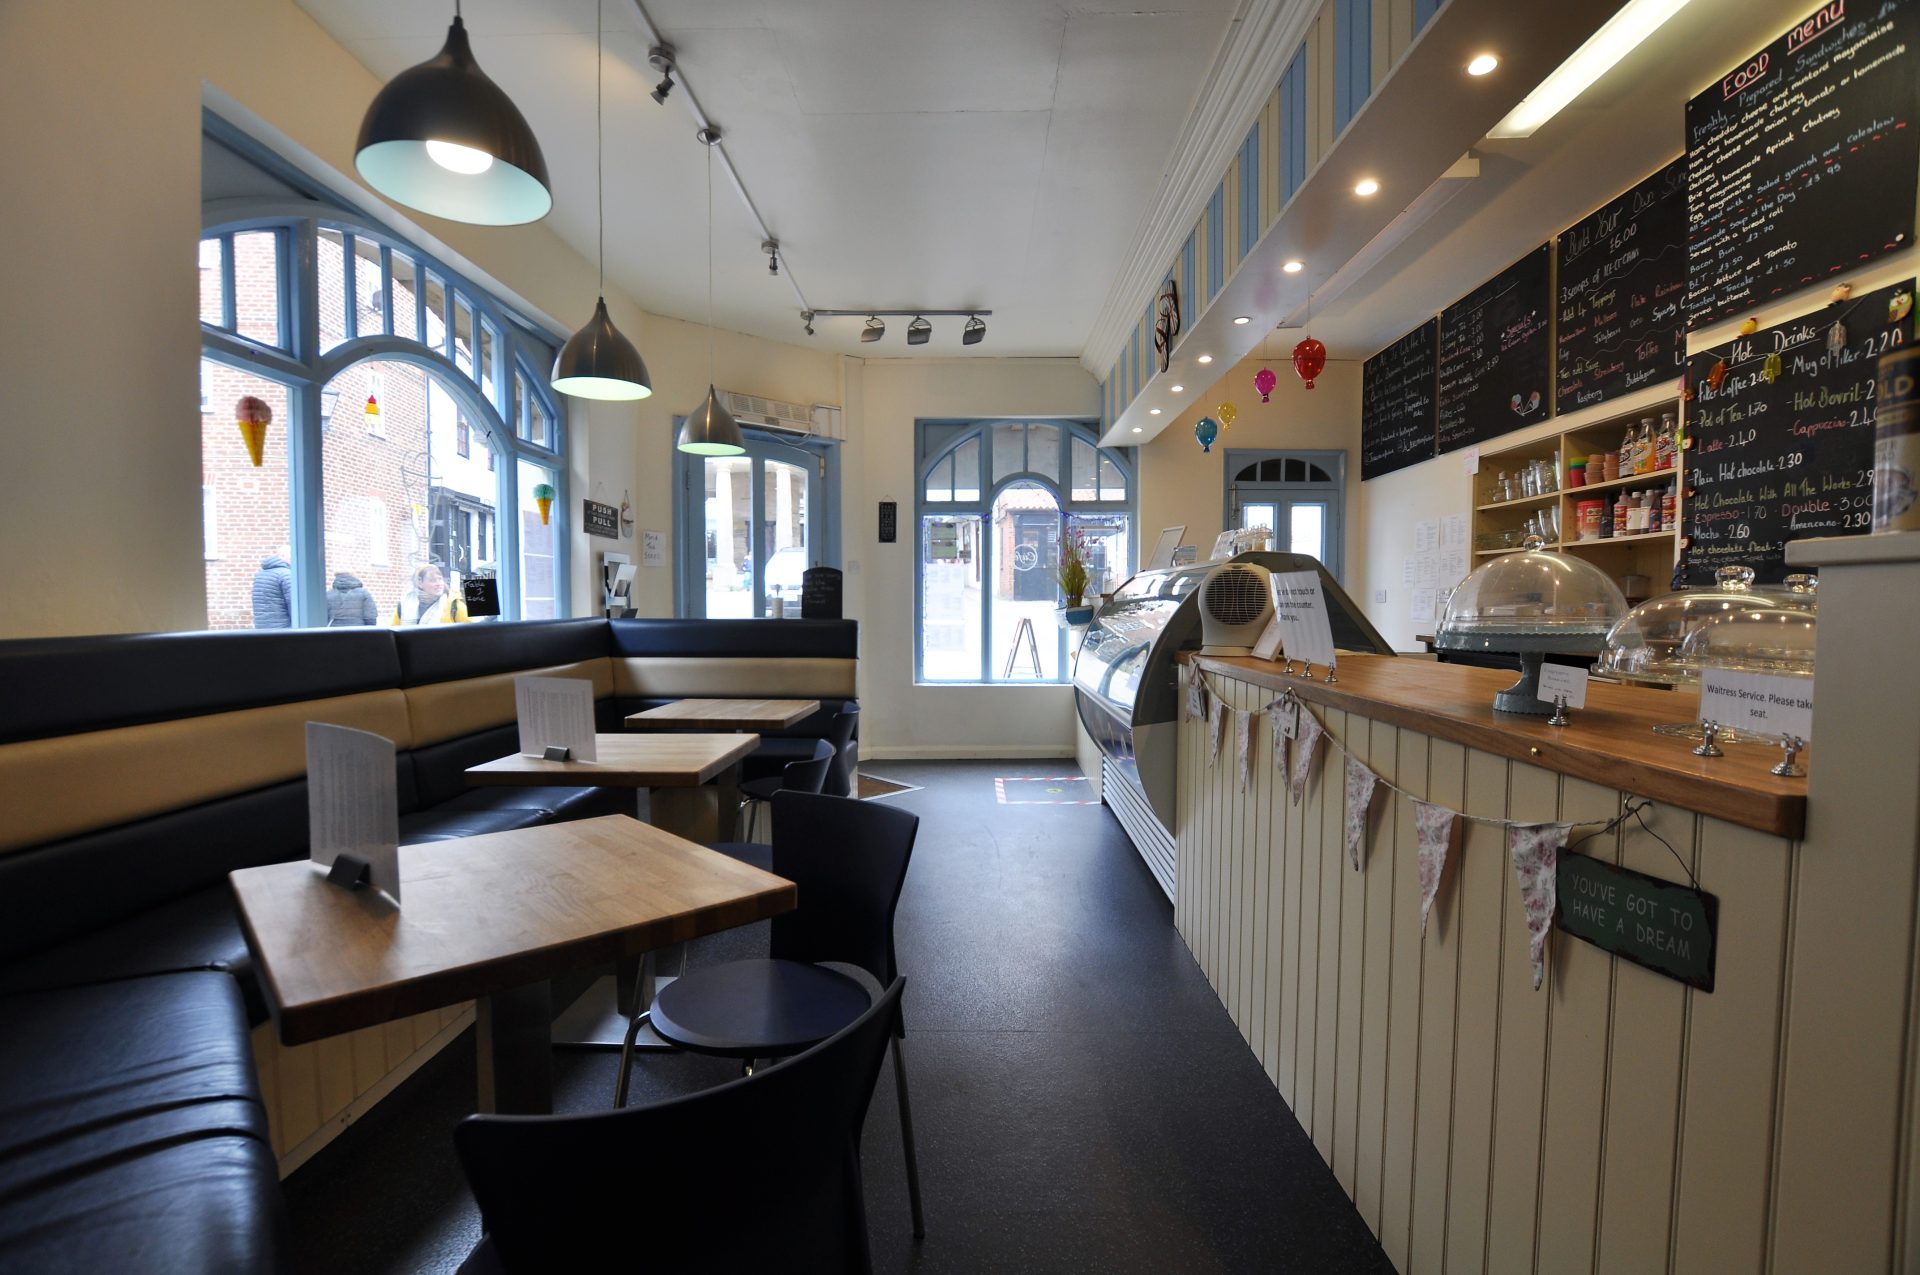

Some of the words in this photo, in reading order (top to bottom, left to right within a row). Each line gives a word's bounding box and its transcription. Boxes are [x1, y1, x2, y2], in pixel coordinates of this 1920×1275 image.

[1722, 52, 1769, 97] FOOD
[1741, 102, 1768, 124] cheese
[1772, 88, 1788, 103] and
[1791, 61, 1830, 90] mustard
[1833, 20, 1895, 63] mayonnaise
[1739, 67, 1783, 107] Prepared
[1716, 144, 1742, 164] cheese
[1744, 132, 1759, 146] and
[1764, 115, 1787, 133] onion
[1792, 106, 1801, 116] or
[1804, 84, 1836, 108] tomato
[1840, 76, 1850, 86] or
[1853, 44, 1906, 79] homemade
[1707, 145, 1720, 158] and
[1724, 117, 1765, 146] homemade
[1687, 190, 1703, 203] Brie
[1705, 180, 1720, 193] and
[1722, 154, 1761, 182] homemade
[1765, 131, 1795, 155] Apricot
[1726, 198, 1744, 212] with
[1823, 142, 1840, 157] and
[1687, 202, 1706, 213] Tuna
[1751, 209, 1758, 218] of
[1761, 201, 1774, 213] the
[1777, 191, 1796, 204] Day
[1689, 213, 1704, 228] Egg
[1714, 234, 1731, 247] with
[1742, 215, 1766, 233] bread
[1768, 205, 1784, 219] roll
[1689, 258, 1714, 274] Bacon
[1718, 246, 1736, 259] Bun
[1746, 257, 1761, 271] and
[1764, 240, 1797, 260] Tomato
[1731, 341, 1753, 365] Hot
[1772, 325, 1816, 355] Drinks
[1792, 355, 1817, 377] Mug
[1720, 372, 1748, 398] Coffee
[1794, 391, 1815, 411] Hot
[1715, 408, 1725, 426] of
[1692, 468, 1714, 487] Plain
[1784, 482, 1797, 497] All
[592, 504, 612, 516] PUSH
[1781, 498, 1830, 517] Double
[1842, 511, 1871, 528] 2.30
[592, 516, 612, 527] PULL
[1707, 684, 1737, 698] Waitress
[1738, 689, 1767, 703] Service.
[1768, 693, 1795, 708] Please
[1796, 698, 1813, 710] tak
[1750, 708, 1768, 719] seat.
[1572, 873, 1616, 906] YOU'VE
[1626, 893, 1659, 919] GOT
[1669, 907, 1693, 932] TO
[1572, 897, 1606, 927] HAVE
[1616, 917, 1624, 934] A
[1636, 922, 1691, 961] DREAM
